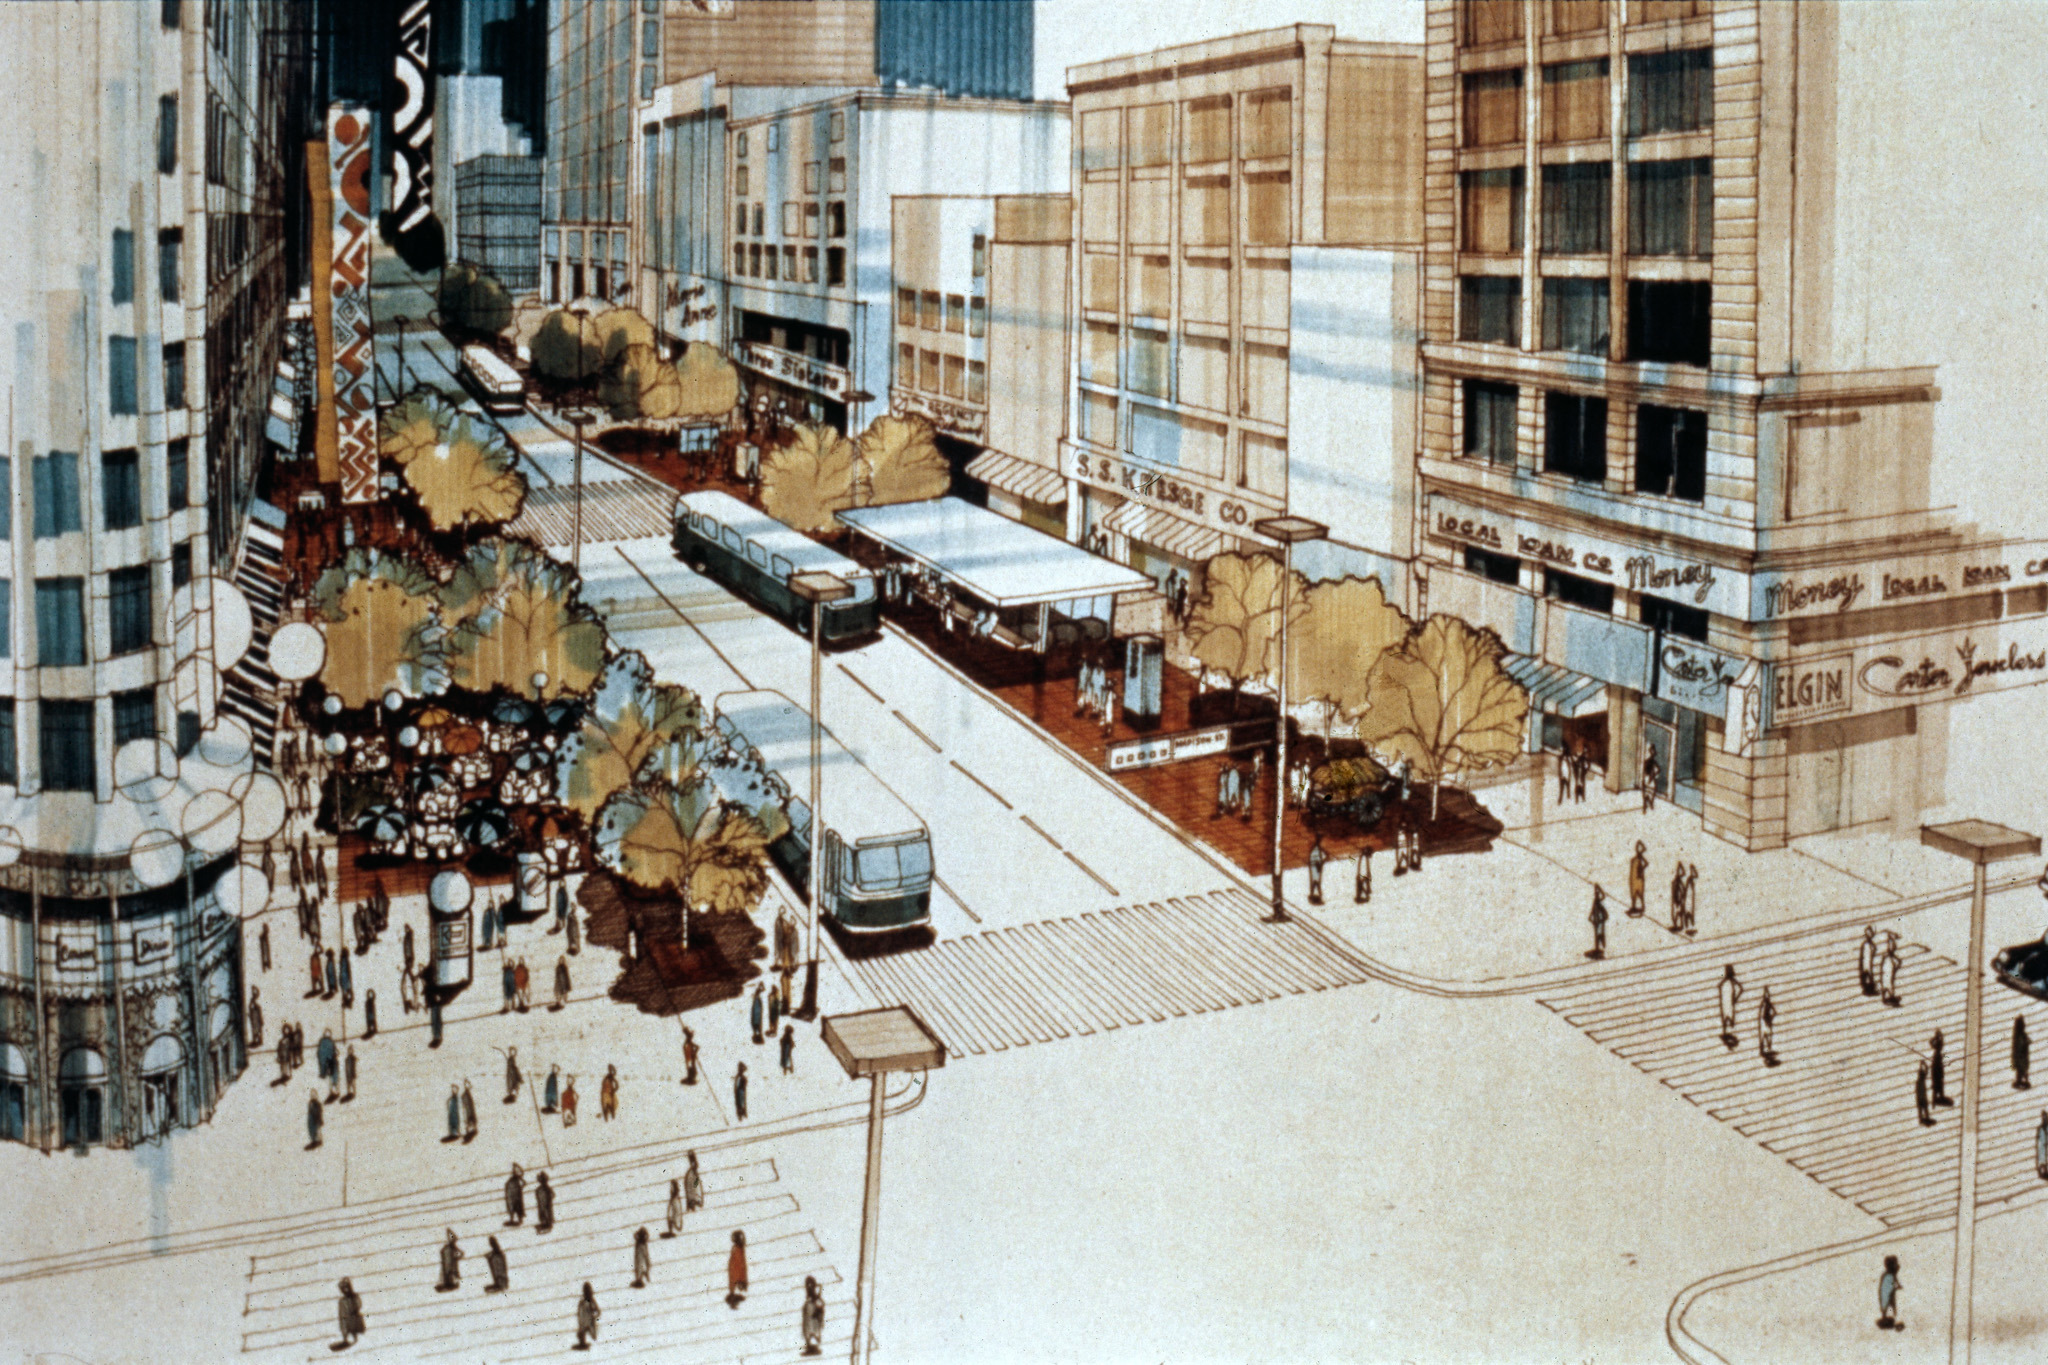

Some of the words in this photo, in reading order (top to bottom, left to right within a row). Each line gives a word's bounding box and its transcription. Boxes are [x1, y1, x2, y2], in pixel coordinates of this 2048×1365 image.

[781, 356, 839, 391] Sisters
[1077, 453, 1094, 478] S.
[1098, 459, 1115, 483] S.
[1219, 500, 1253, 527] CO.
[1624, 554, 1717, 603] Money
[1765, 573, 1865, 618] Money
[1775, 668, 1843, 711] ELGIN
